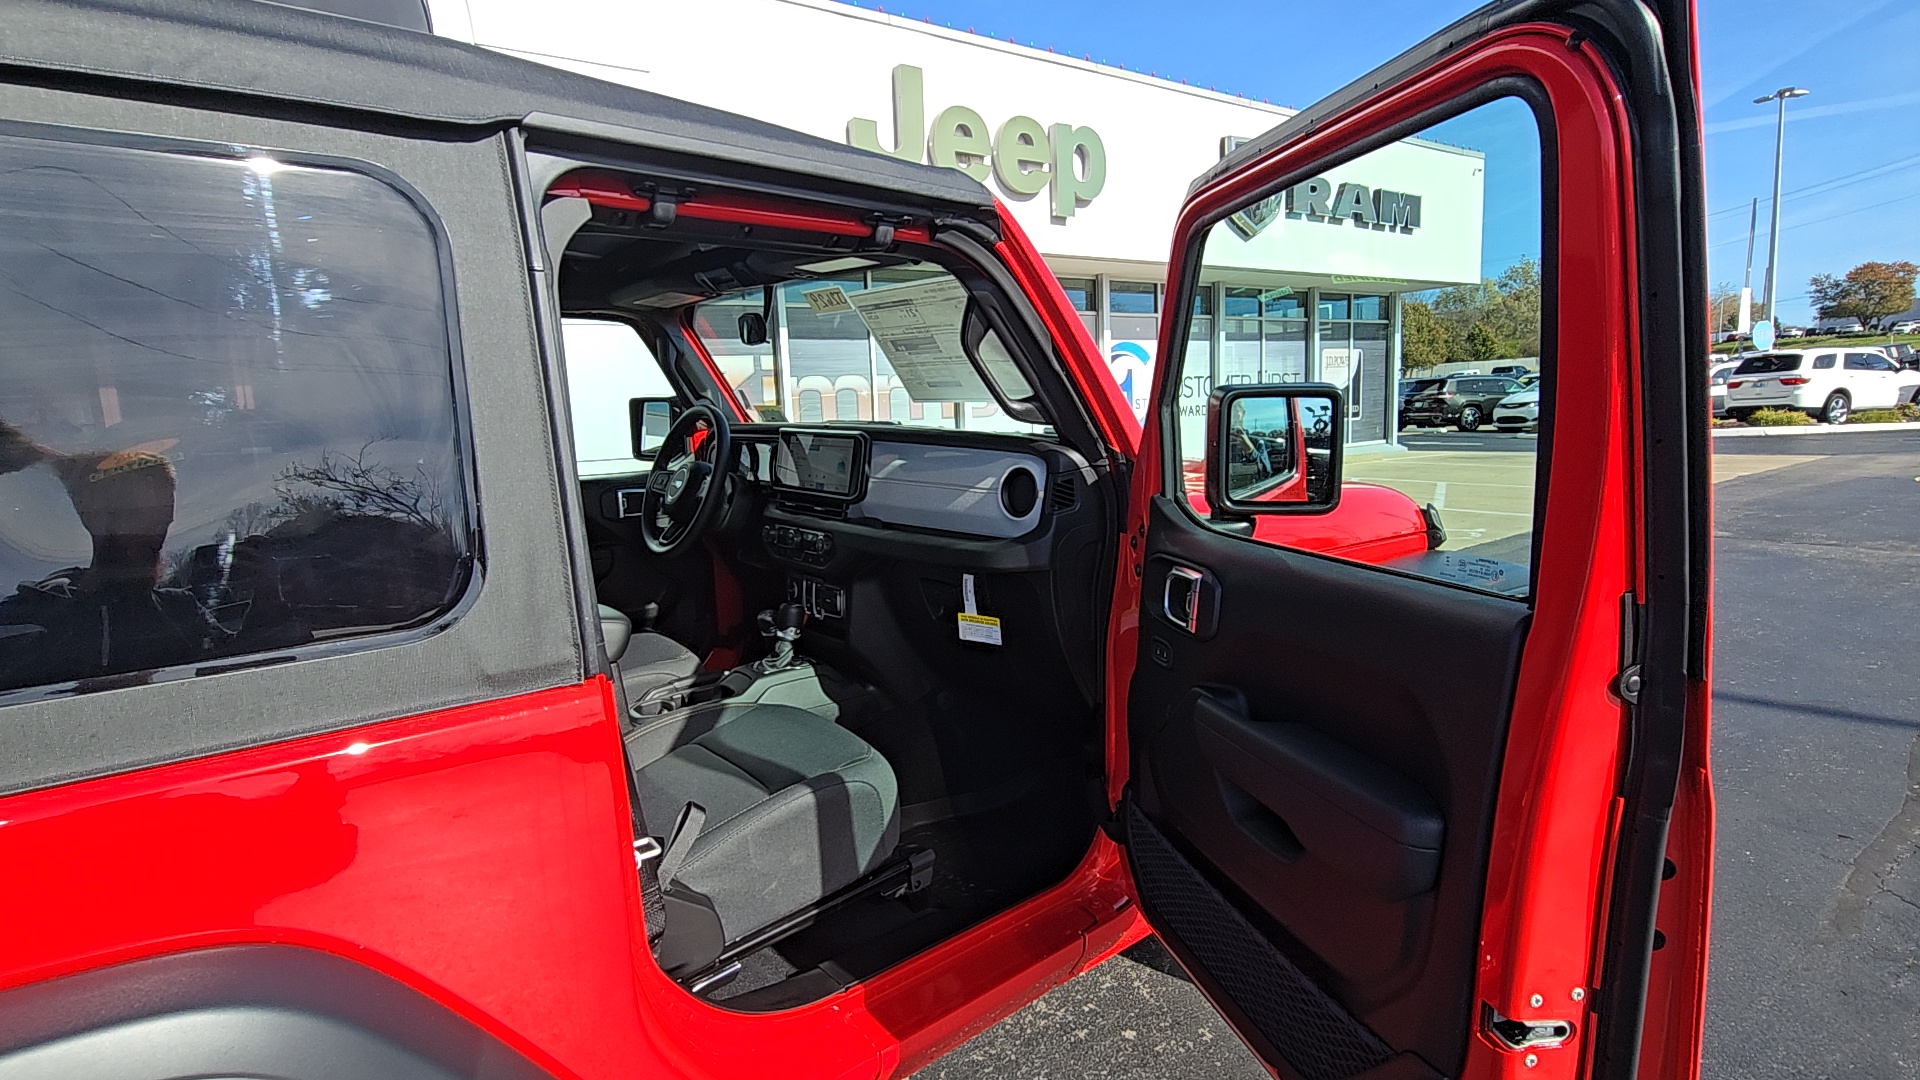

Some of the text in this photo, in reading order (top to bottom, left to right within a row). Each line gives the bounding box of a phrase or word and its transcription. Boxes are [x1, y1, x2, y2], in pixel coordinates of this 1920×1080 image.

[847, 63, 1107, 217] Jeep
[1287, 177, 1422, 230] RAM
[1334, 355, 1350, 367] POWE
